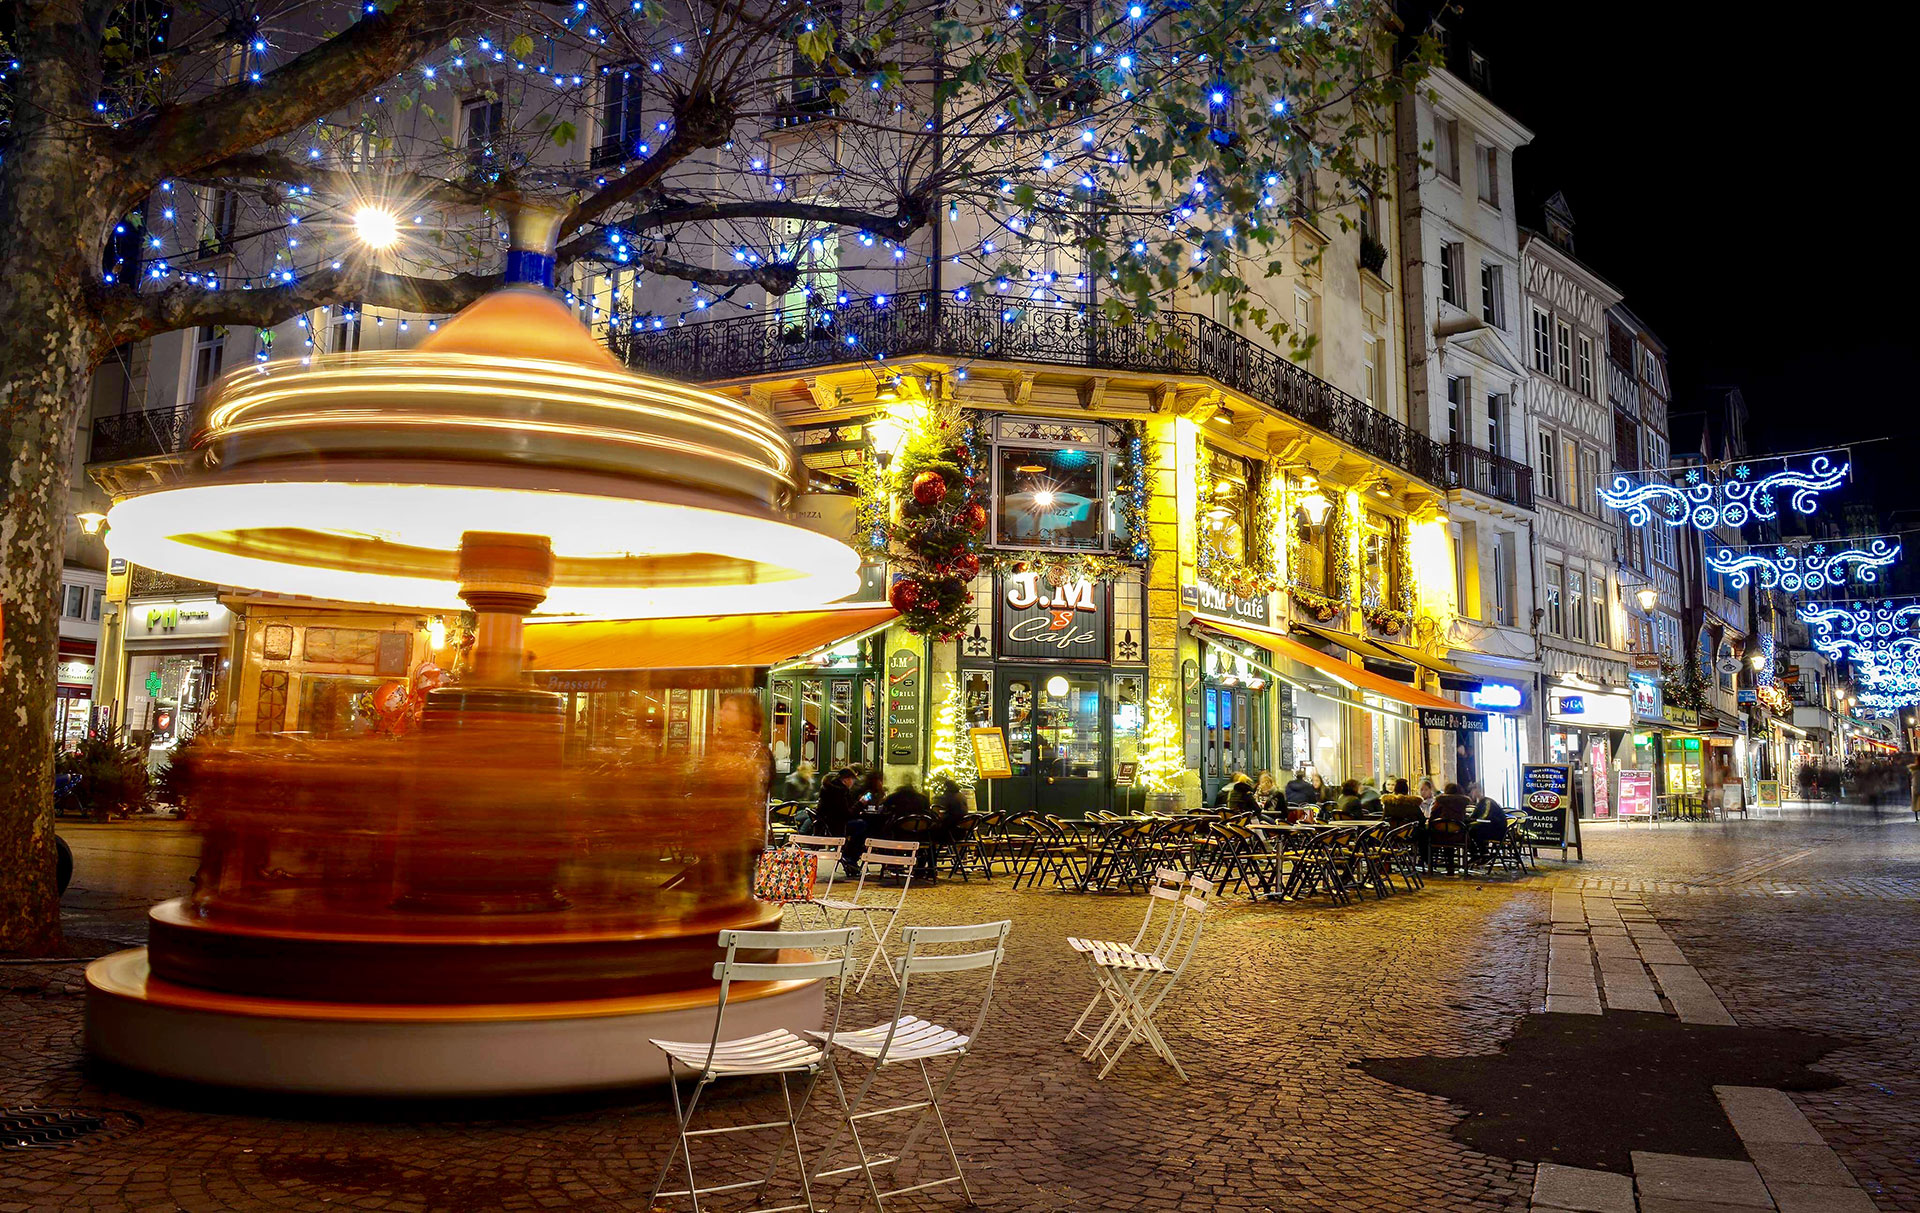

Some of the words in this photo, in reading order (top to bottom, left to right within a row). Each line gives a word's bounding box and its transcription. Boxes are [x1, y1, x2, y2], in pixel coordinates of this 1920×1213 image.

[799, 511, 823, 520] PIZZA
[1007, 571, 1097, 612] J.M
[1234, 594, 1265, 619] Café
[147, 607, 177, 630] PH
[1008, 616, 1097, 649] Café
[547, 675, 608, 690] Brasserie
[890, 687, 915, 698] GRILL
[891, 700, 915, 711] PIZZAS
[889, 714, 916, 726] SALADES
[1462, 715, 1485, 730] Brasserie
[1529, 815, 1559, 823] SALADES
